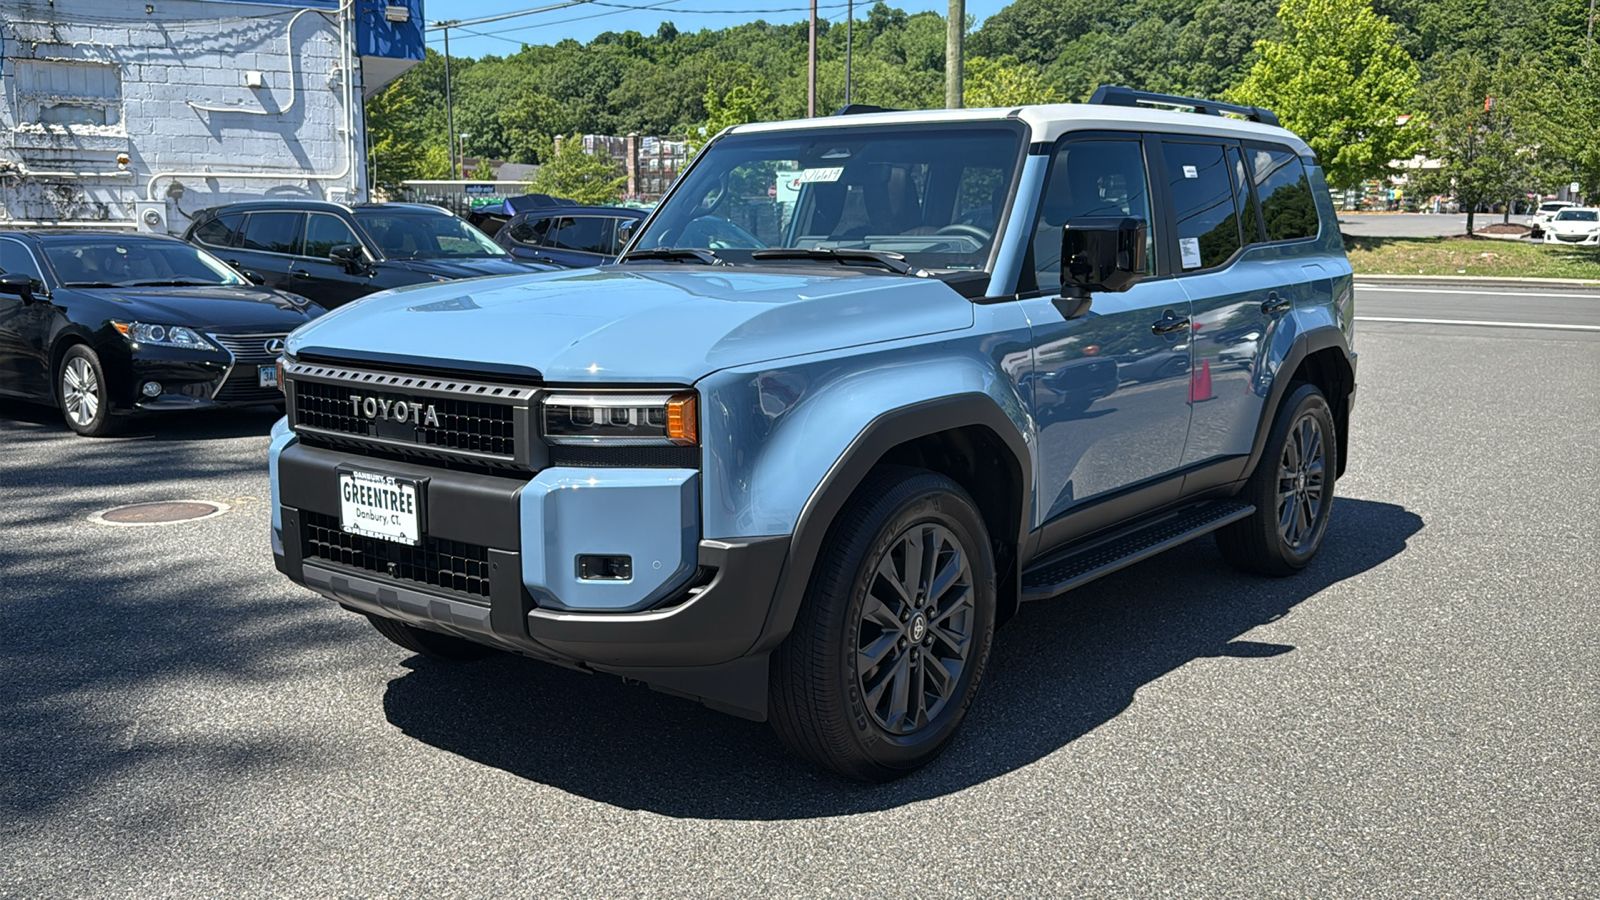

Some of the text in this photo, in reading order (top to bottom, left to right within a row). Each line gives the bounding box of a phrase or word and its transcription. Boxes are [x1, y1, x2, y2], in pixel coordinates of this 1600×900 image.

[349, 395, 440, 427] TOYOTA
[343, 481, 413, 515] GREENTREE
[356, 507, 401, 526] Danbury, CT.
[343, 526, 415, 546] GREENTREE
[960, 622, 994, 713] YOKOHAMA
